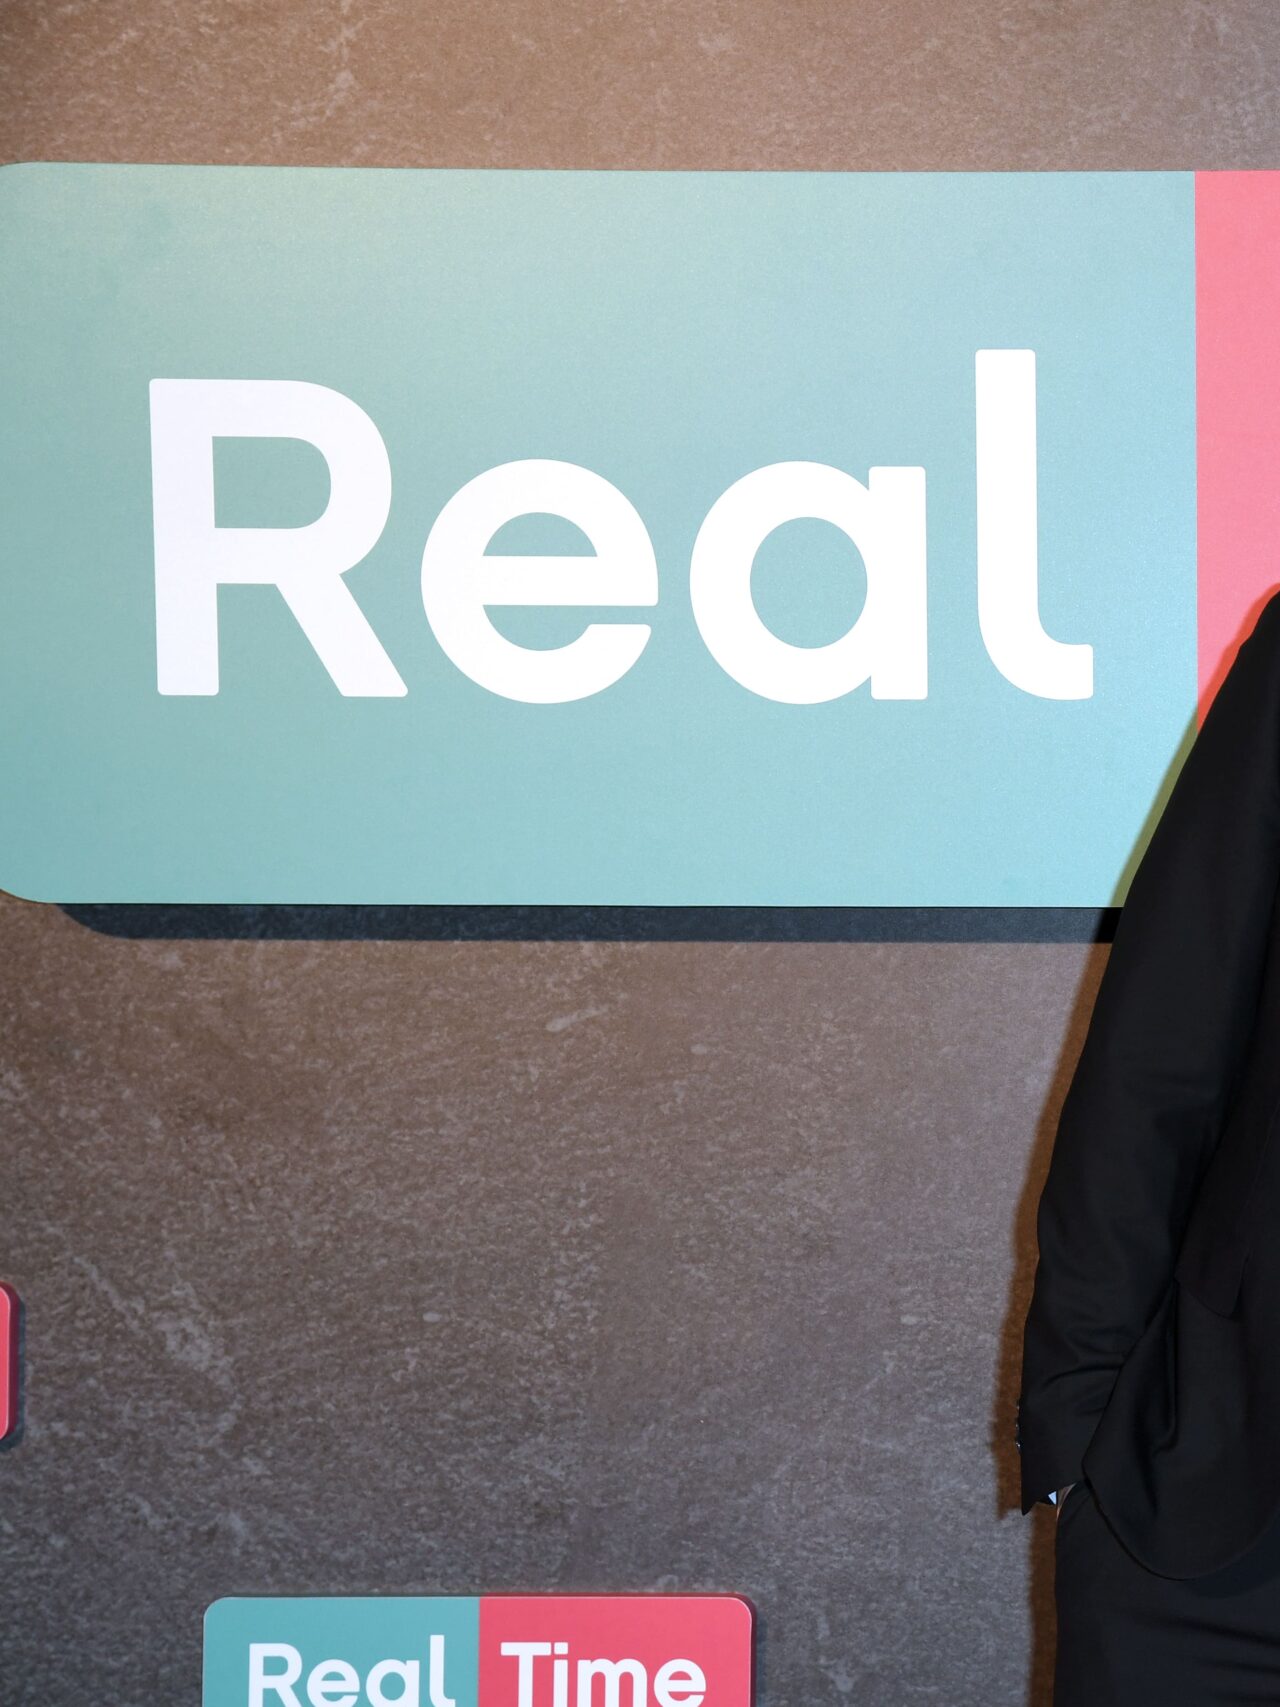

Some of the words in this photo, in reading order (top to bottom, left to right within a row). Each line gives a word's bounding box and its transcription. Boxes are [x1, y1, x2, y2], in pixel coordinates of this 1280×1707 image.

[149, 349, 1093, 704] Real
[248, 1635, 456, 1707] Real
[501, 1642, 707, 1707] Time
